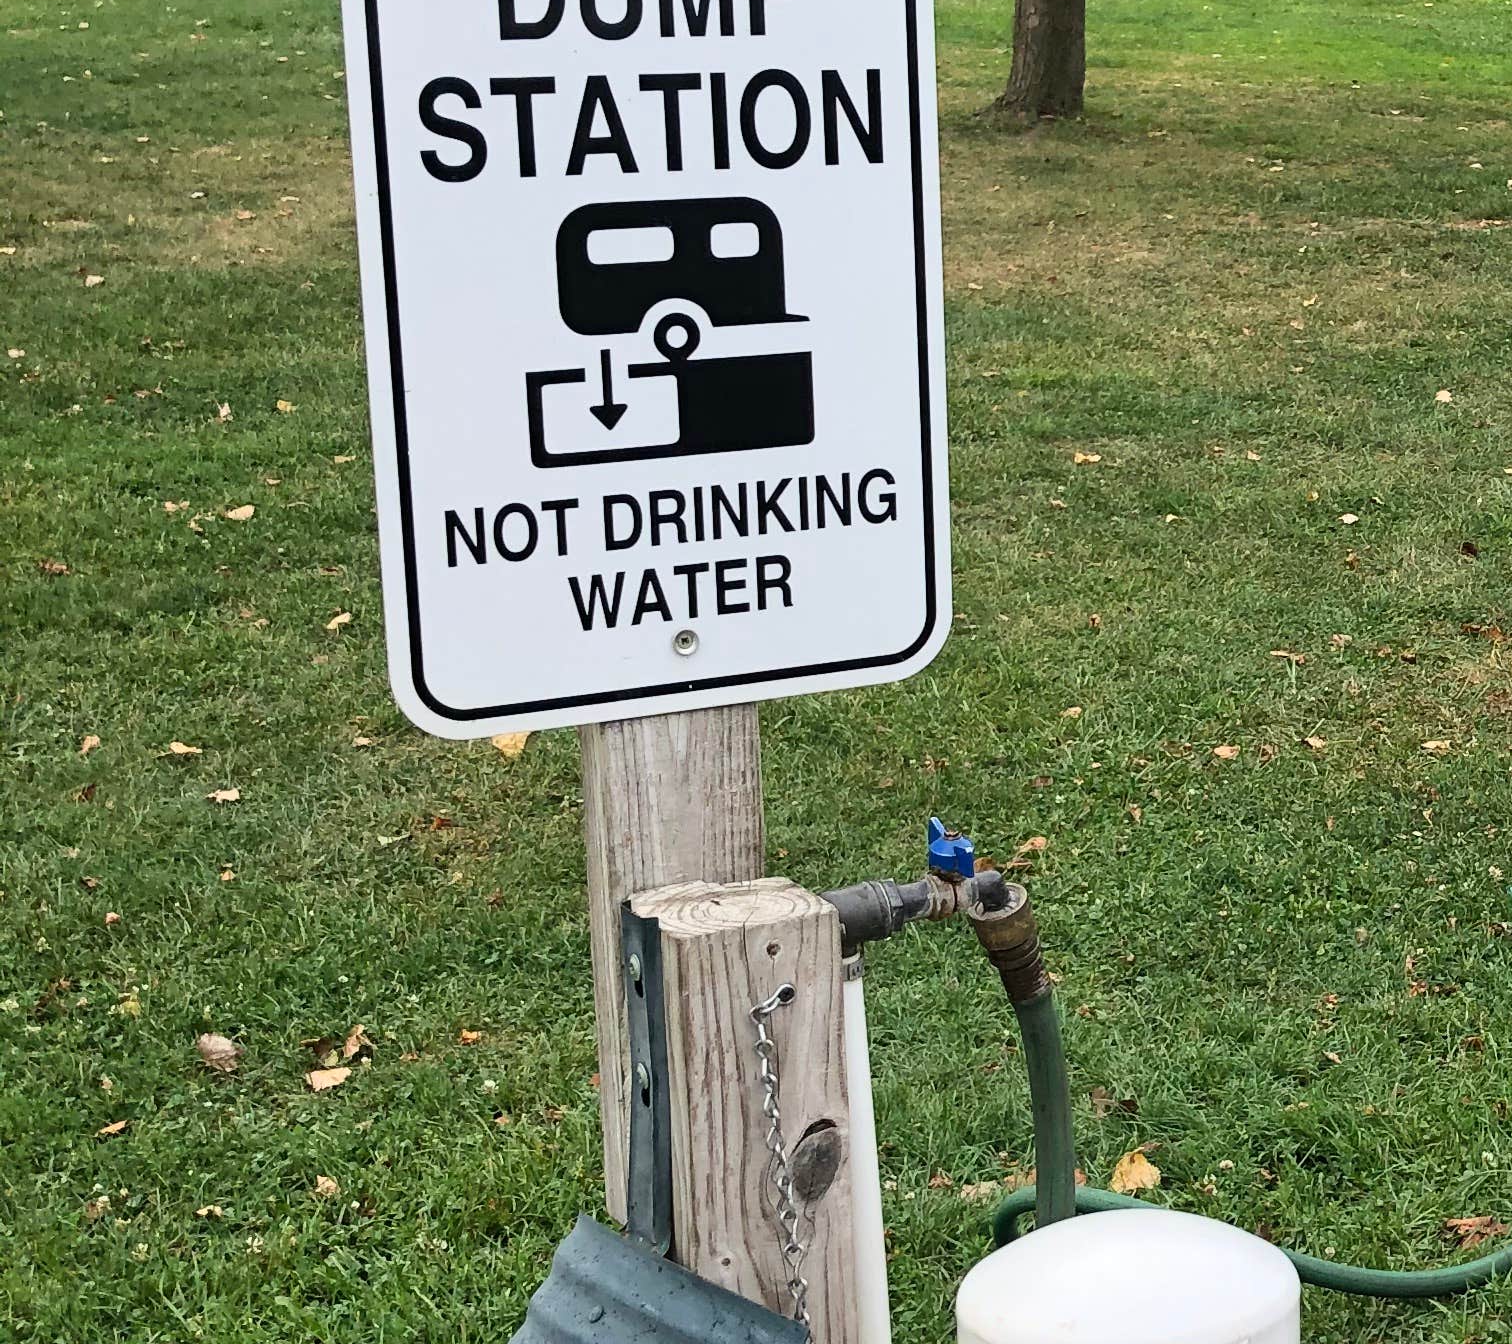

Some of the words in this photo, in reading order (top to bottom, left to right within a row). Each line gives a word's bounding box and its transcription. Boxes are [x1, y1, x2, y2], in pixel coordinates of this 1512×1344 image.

[418, 68, 884, 183] STATION
[444, 497, 579, 568] NOT
[602, 468, 897, 552] DRINKING
[567, 554, 794, 632] WATER
